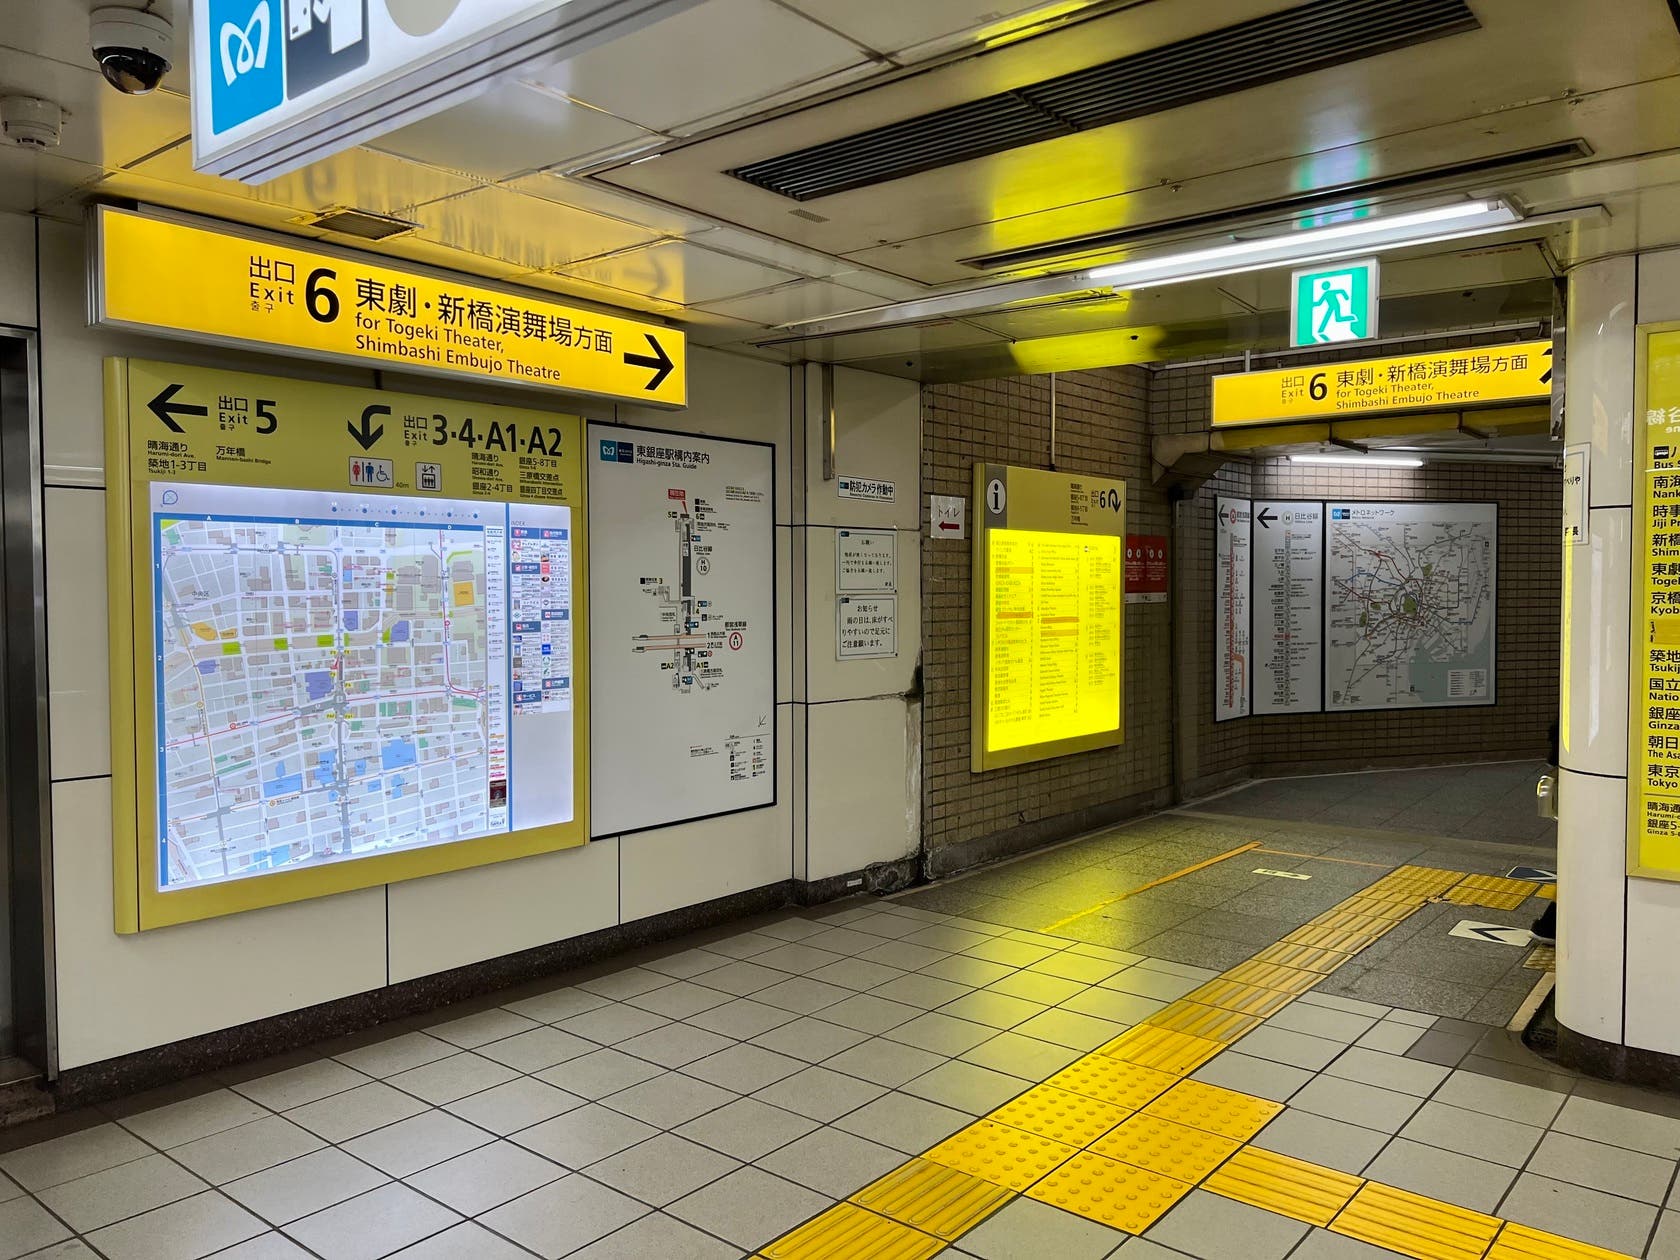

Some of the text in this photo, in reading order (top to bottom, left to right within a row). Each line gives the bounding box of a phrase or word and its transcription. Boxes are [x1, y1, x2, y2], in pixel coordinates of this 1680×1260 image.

[250, 256, 295, 285] 出口
[250, 283, 295, 305] Exit
[305, 267, 340, 323] 6
[355, 278, 613, 354] 東劇・新橋演舞場方面
[355, 312, 504, 353] for Togeki Theater,
[356, 334, 561, 380] Shimbashi Embujo Theatre
[1336, 354, 1528, 388] 東劇・新橋演舞場方面
[1281, 375, 1304, 388] 出口
[1309, 372, 1328, 401] 6
[1281, 389, 1304, 398] Exit
[1336, 382, 1434, 398] for Togeki Theater,
[218, 396, 248, 412] 出口
[1336, 390, 1479, 409] Shimbashi Embujo Theatre
[219, 412, 248, 425] Exit
[256, 399, 278, 434] 5
[403, 416, 428, 430] 出口
[404, 430, 428, 441] Exit
[147, 440, 188, 453] 晴海通り
[216, 445, 246, 457] 万年橋
[636, 445, 710, 465] 東銀座駅構内案内
[148, 458, 207, 472] 築地1-3丁目
[636, 458, 671, 469] Higashi-ginza
[682, 462, 697, 470] Guide
[1654, 461, 1674, 470] Bus
[849, 480, 894, 497] 防犯カメラ作動中
[1099, 490, 1106, 509] 6
[937, 505, 960, 518] トイレ
[1652, 519, 1667, 529] Jiji
[1652, 548, 1680, 557] Shim
[1651, 606, 1680, 616] Kyob
[1649, 678, 1680, 691] 国立
[1649, 692, 1679, 701] Natio
[1648, 706, 1680, 720] 銀座
[1648, 721, 1680, 730] Ginza
[1648, 736, 1679, 749] 朝日
[1648, 750, 1664, 759] The
[1648, 764, 1680, 778] 東京
[1648, 778, 1678, 789] Tokyo
[1647, 828, 1668, 836] Ginza
